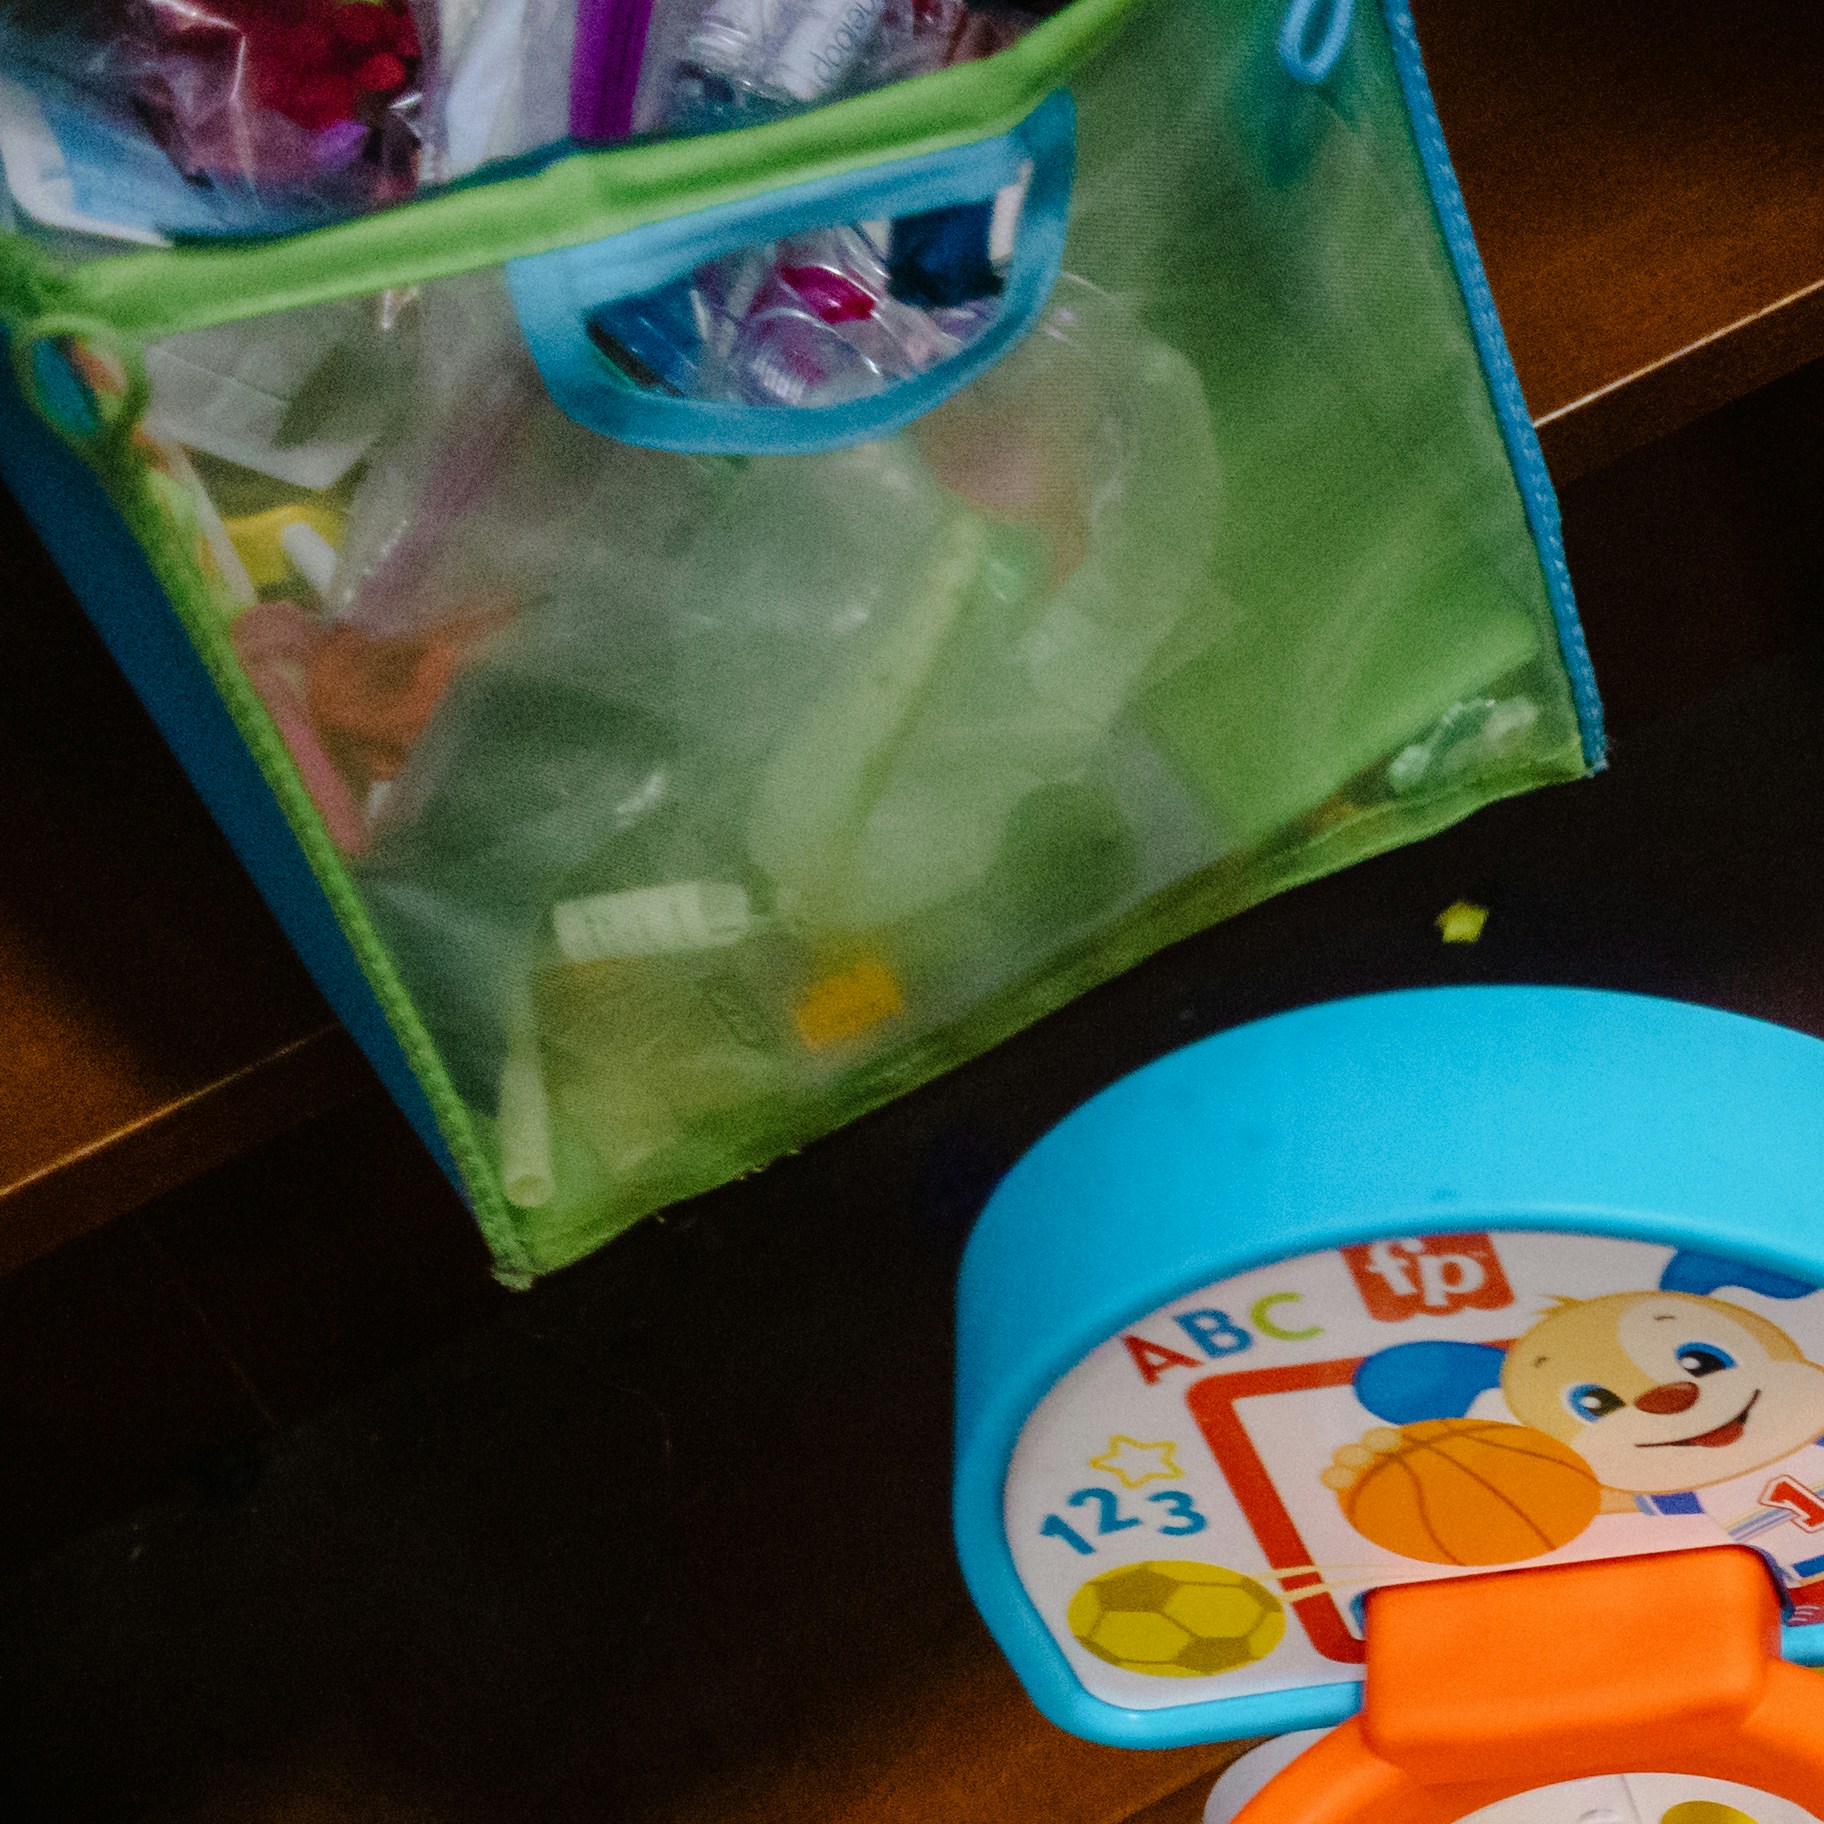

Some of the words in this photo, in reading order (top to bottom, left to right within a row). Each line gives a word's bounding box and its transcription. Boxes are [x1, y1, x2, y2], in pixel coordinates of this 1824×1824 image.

[1366, 1238, 1486, 1308] fp
[1121, 1289, 1325, 1386] ABC
[1037, 1484, 1208, 1556] 123
